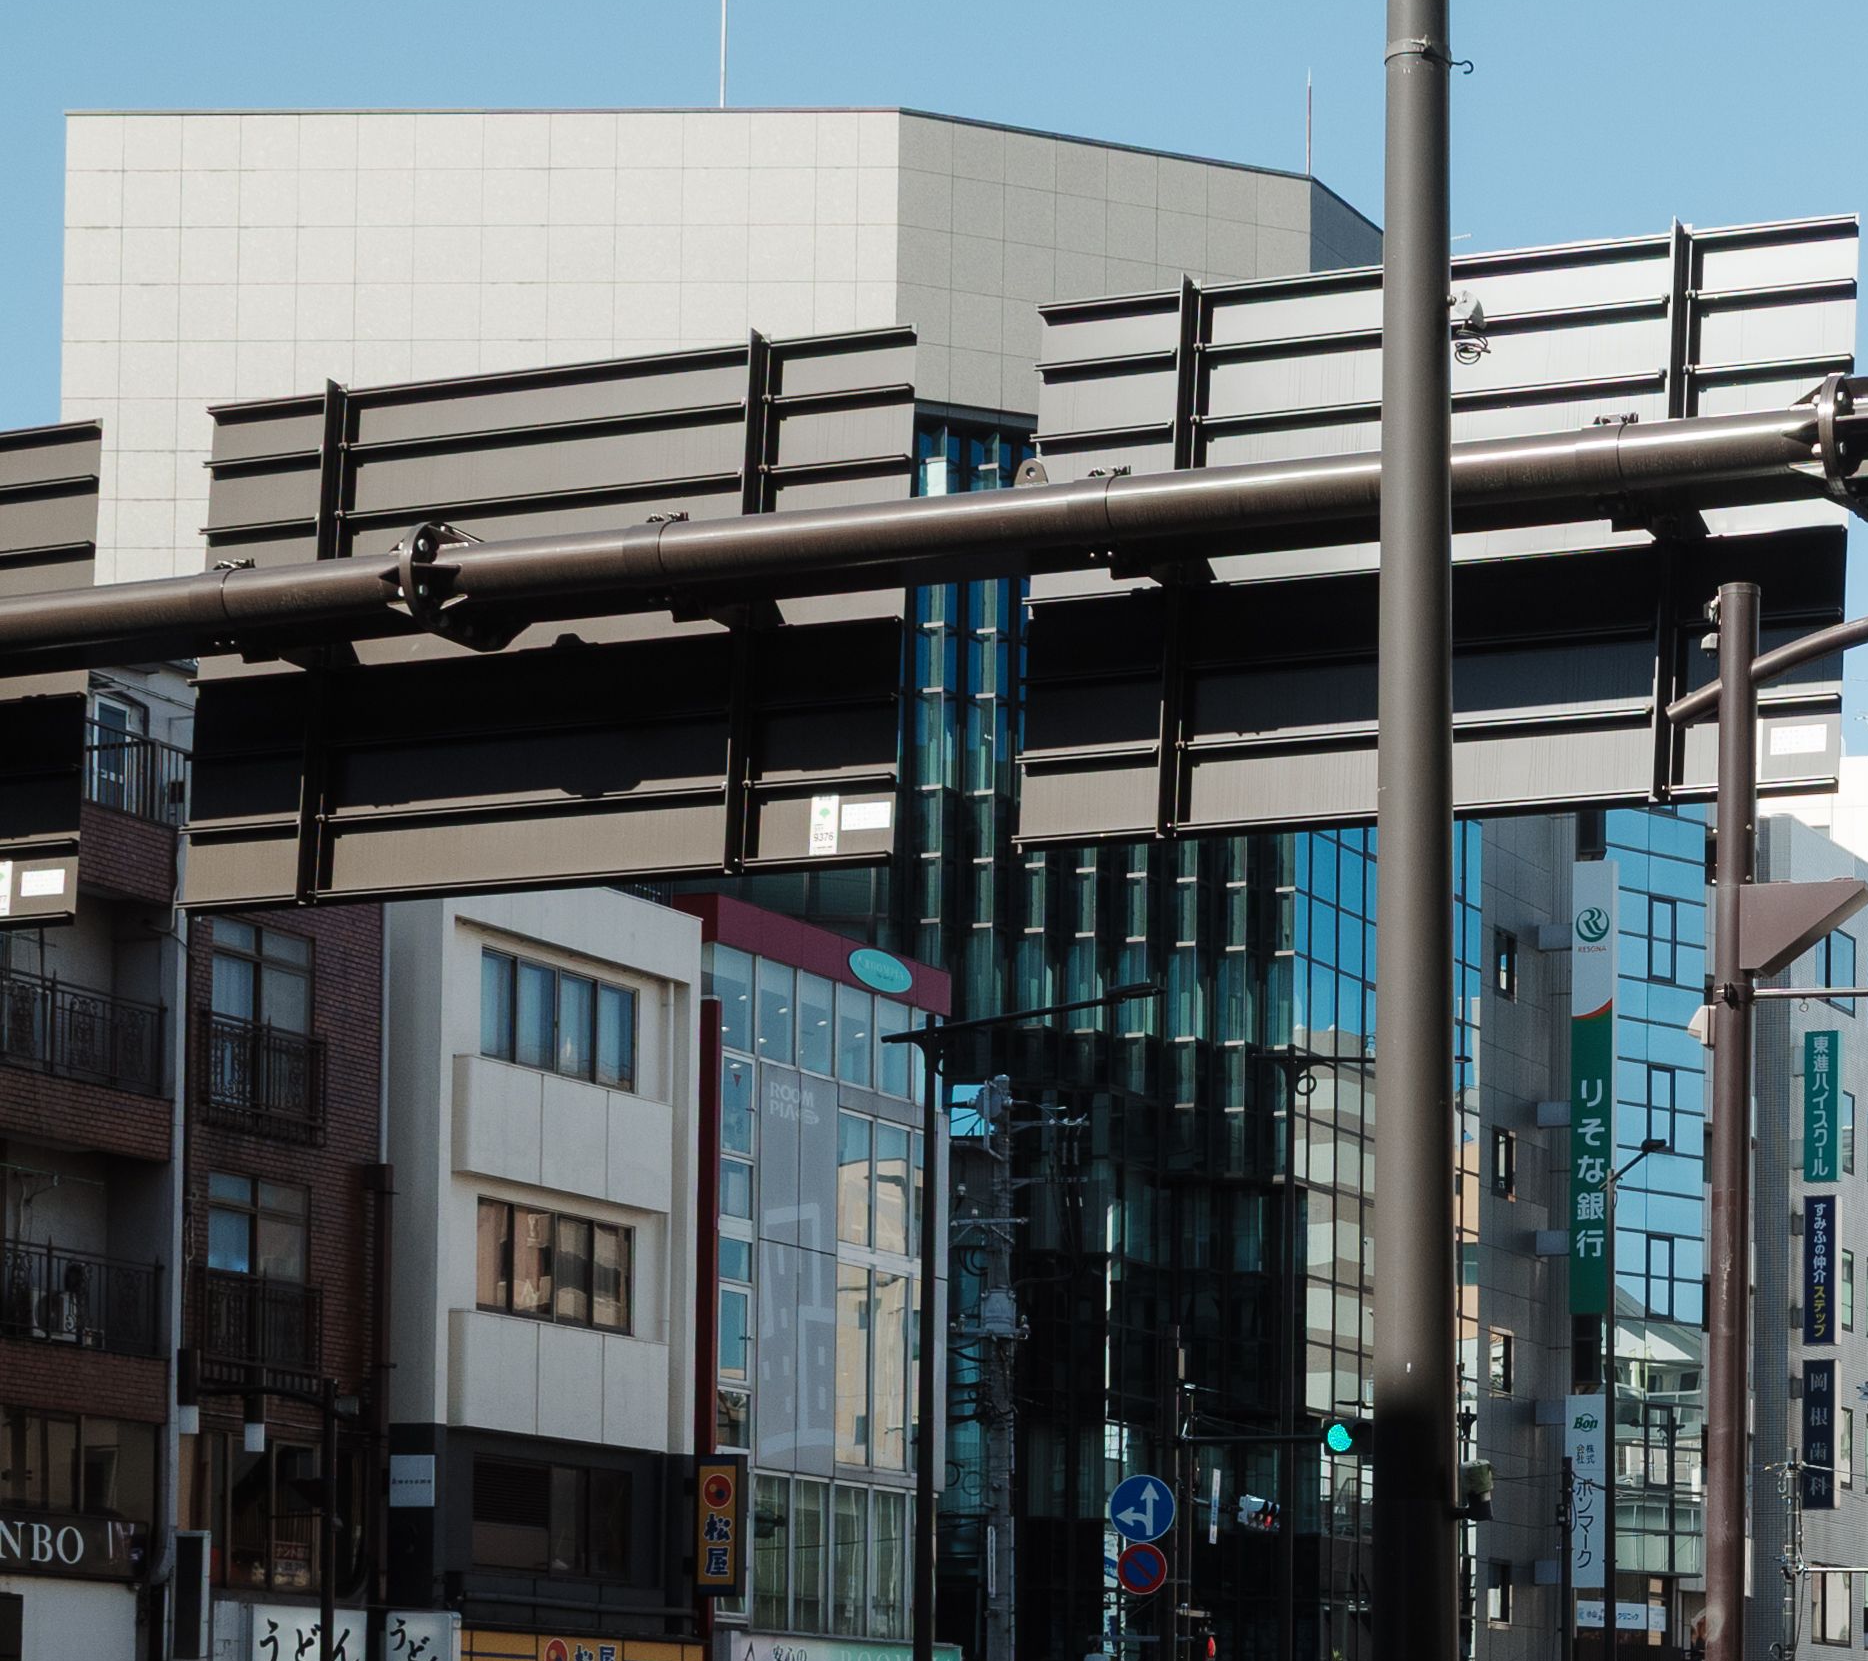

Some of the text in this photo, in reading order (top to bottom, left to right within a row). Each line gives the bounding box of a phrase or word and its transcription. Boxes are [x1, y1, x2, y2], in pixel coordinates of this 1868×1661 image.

[770, 1081, 815, 1108] ROOM
[1812, 1035, 1830, 1178] 東進ハイスクール
[1576, 1078, 1605, 1258] りそな銀行
[1573, 1416, 1598, 1430] Bon
[1809, 1371, 1828, 1497] 岡根歯科
[704, 1513, 731, 1577] 松屋
